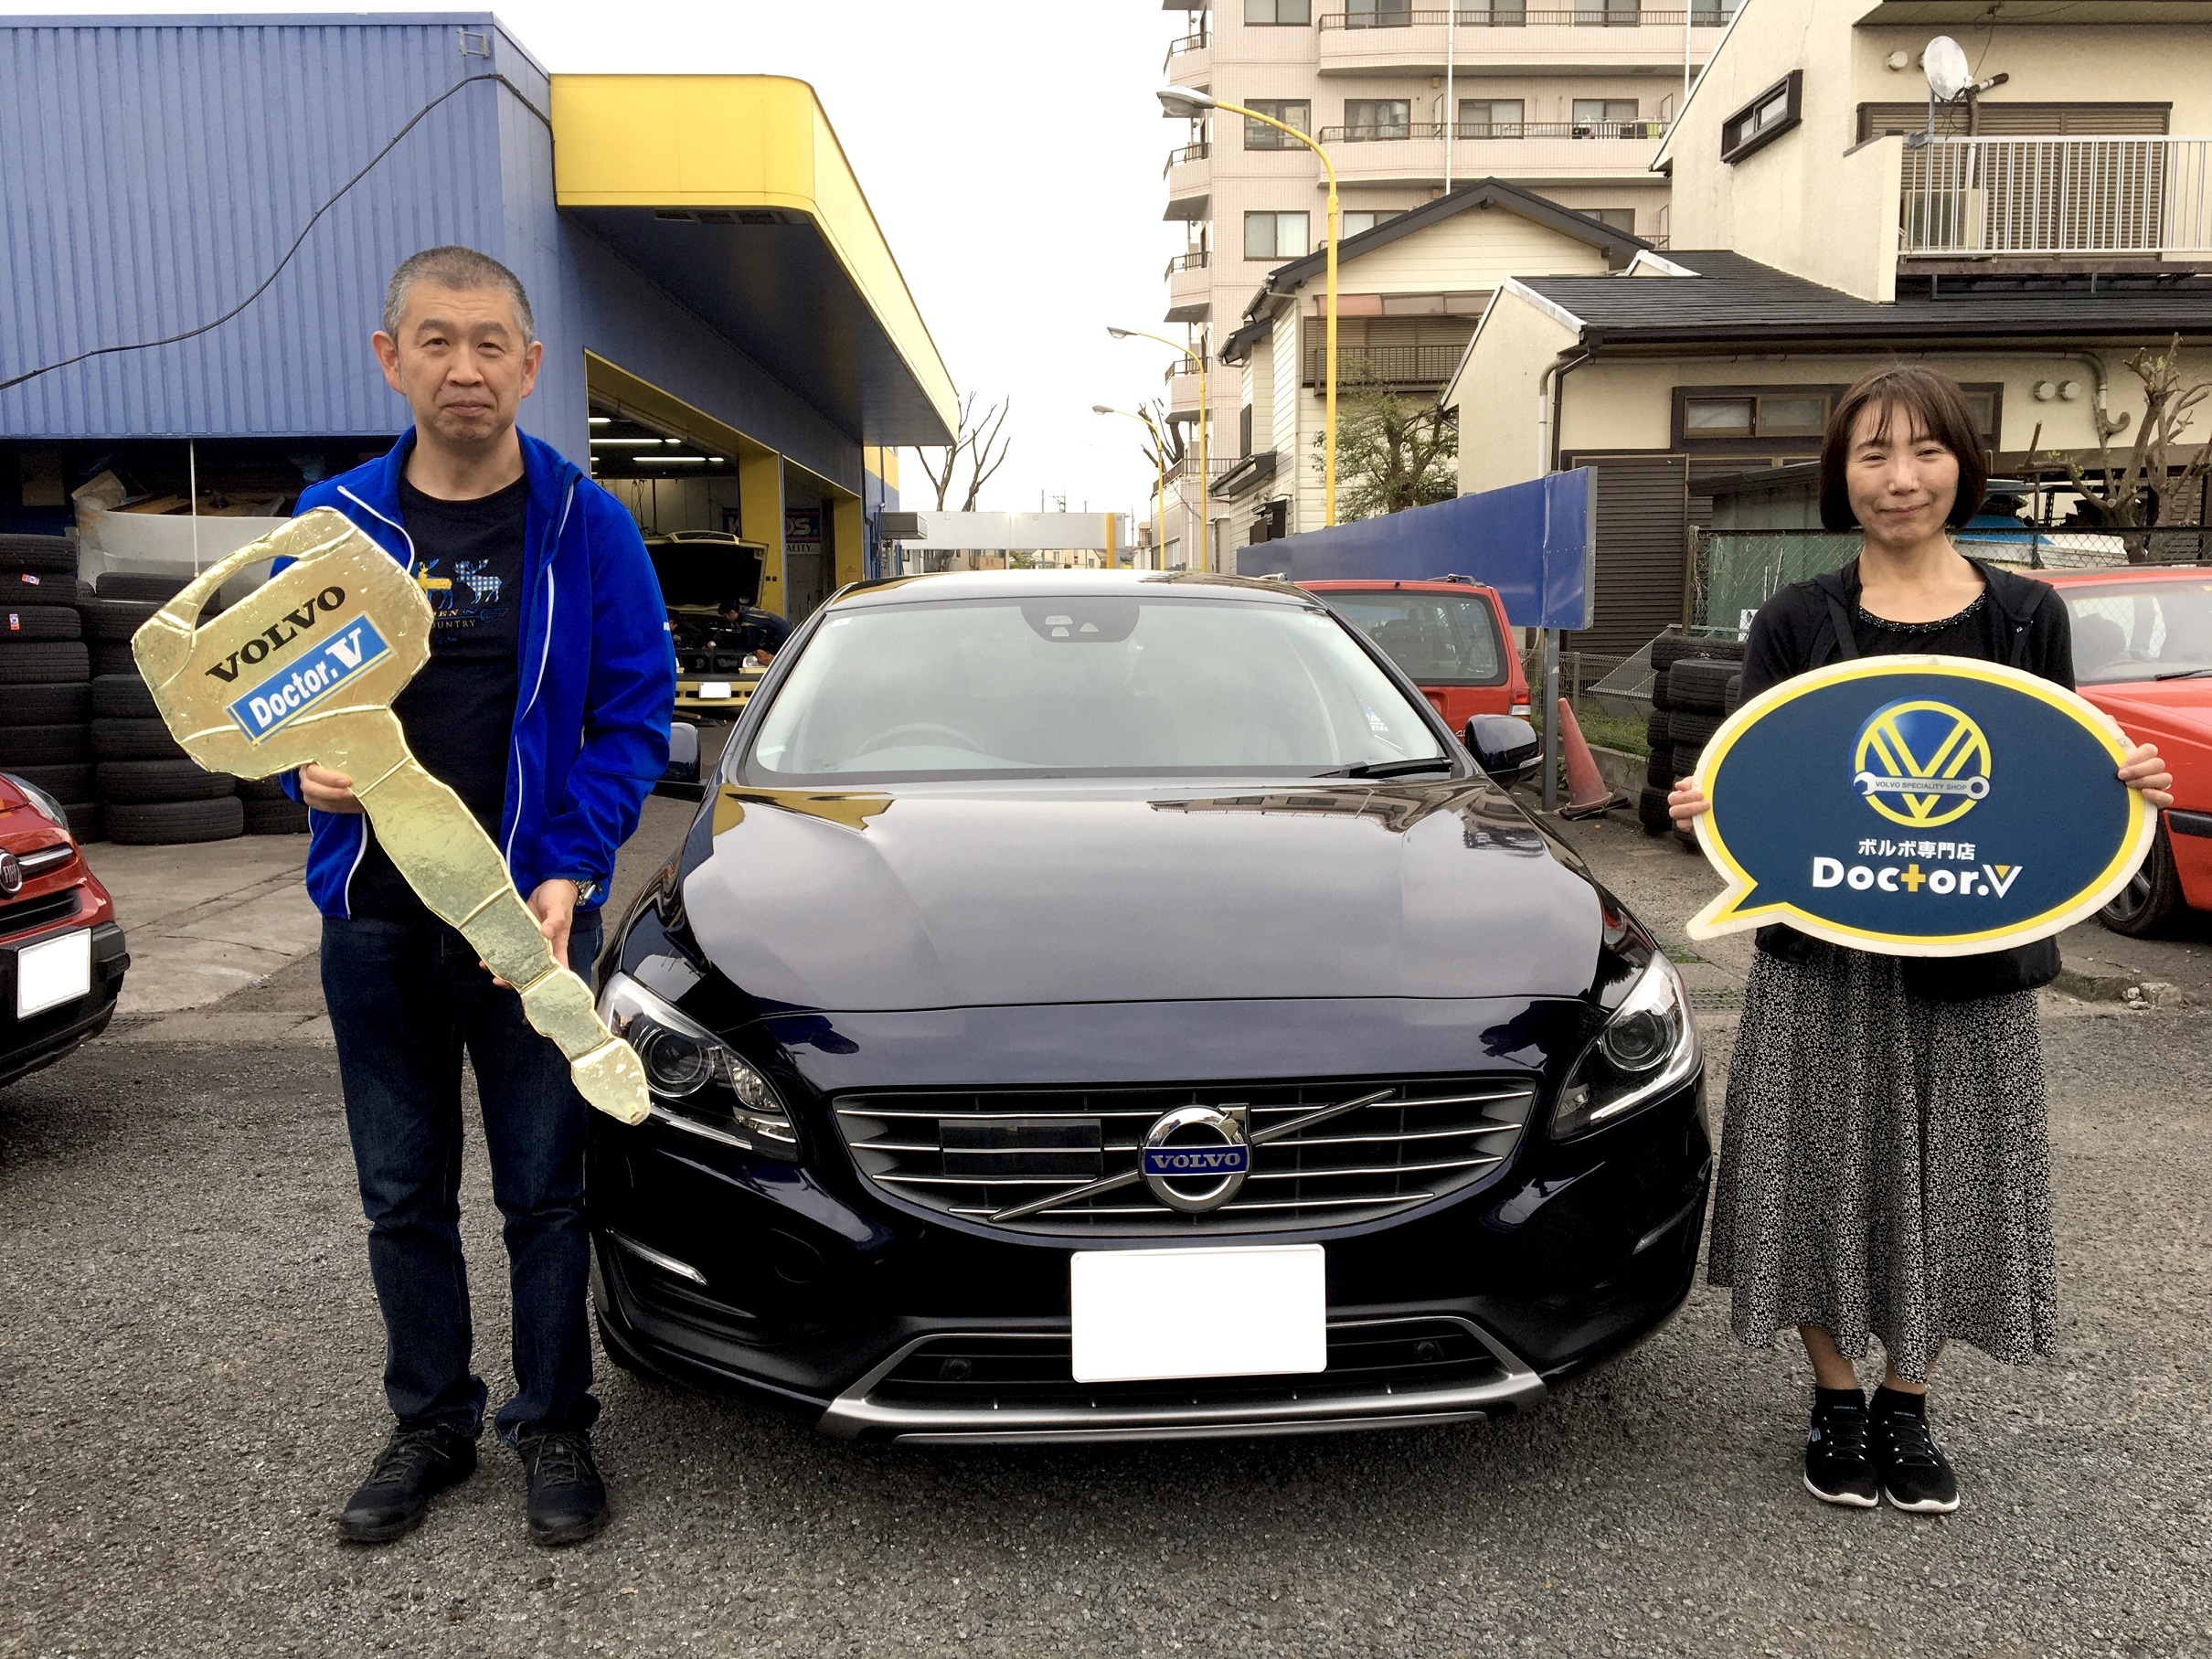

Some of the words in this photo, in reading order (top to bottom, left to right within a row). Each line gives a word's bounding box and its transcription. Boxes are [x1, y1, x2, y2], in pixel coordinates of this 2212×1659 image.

[431, 620, 476, 629] OUNTRY
[205, 586, 345, 682] VOLVO
[1902, 782, 1944, 790] SPECIALITY
[1858, 839, 1975, 860] ボルボ専門店
[3, 865, 17, 883] FIAT
[1813, 857, 2023, 899] Doctor.V
[1151, 1153, 1241, 1168] VOLVO
